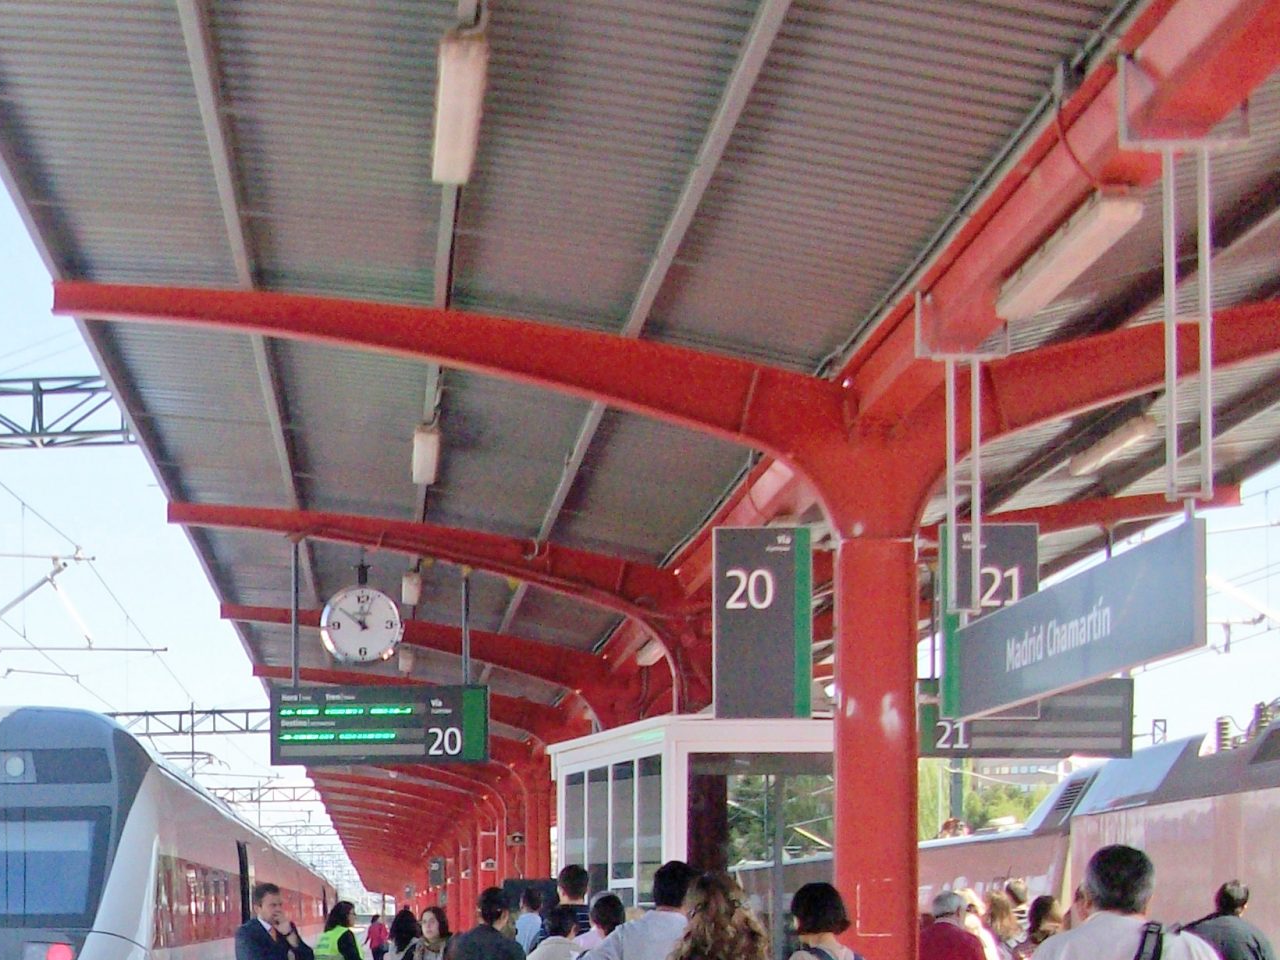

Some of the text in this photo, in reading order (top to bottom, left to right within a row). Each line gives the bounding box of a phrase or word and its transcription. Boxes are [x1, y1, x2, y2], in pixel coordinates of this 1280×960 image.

[725, 569, 773, 609] 20
[980, 568, 1022, 607] 21
[332, 622, 341, 630] 9
[385, 620, 393, 629] 3
[1006, 596, 1111, 673] Madrid Chamartín
[359, 647, 367, 656] 6
[428, 728, 462, 756] 20
[937, 721, 969, 749] 21
